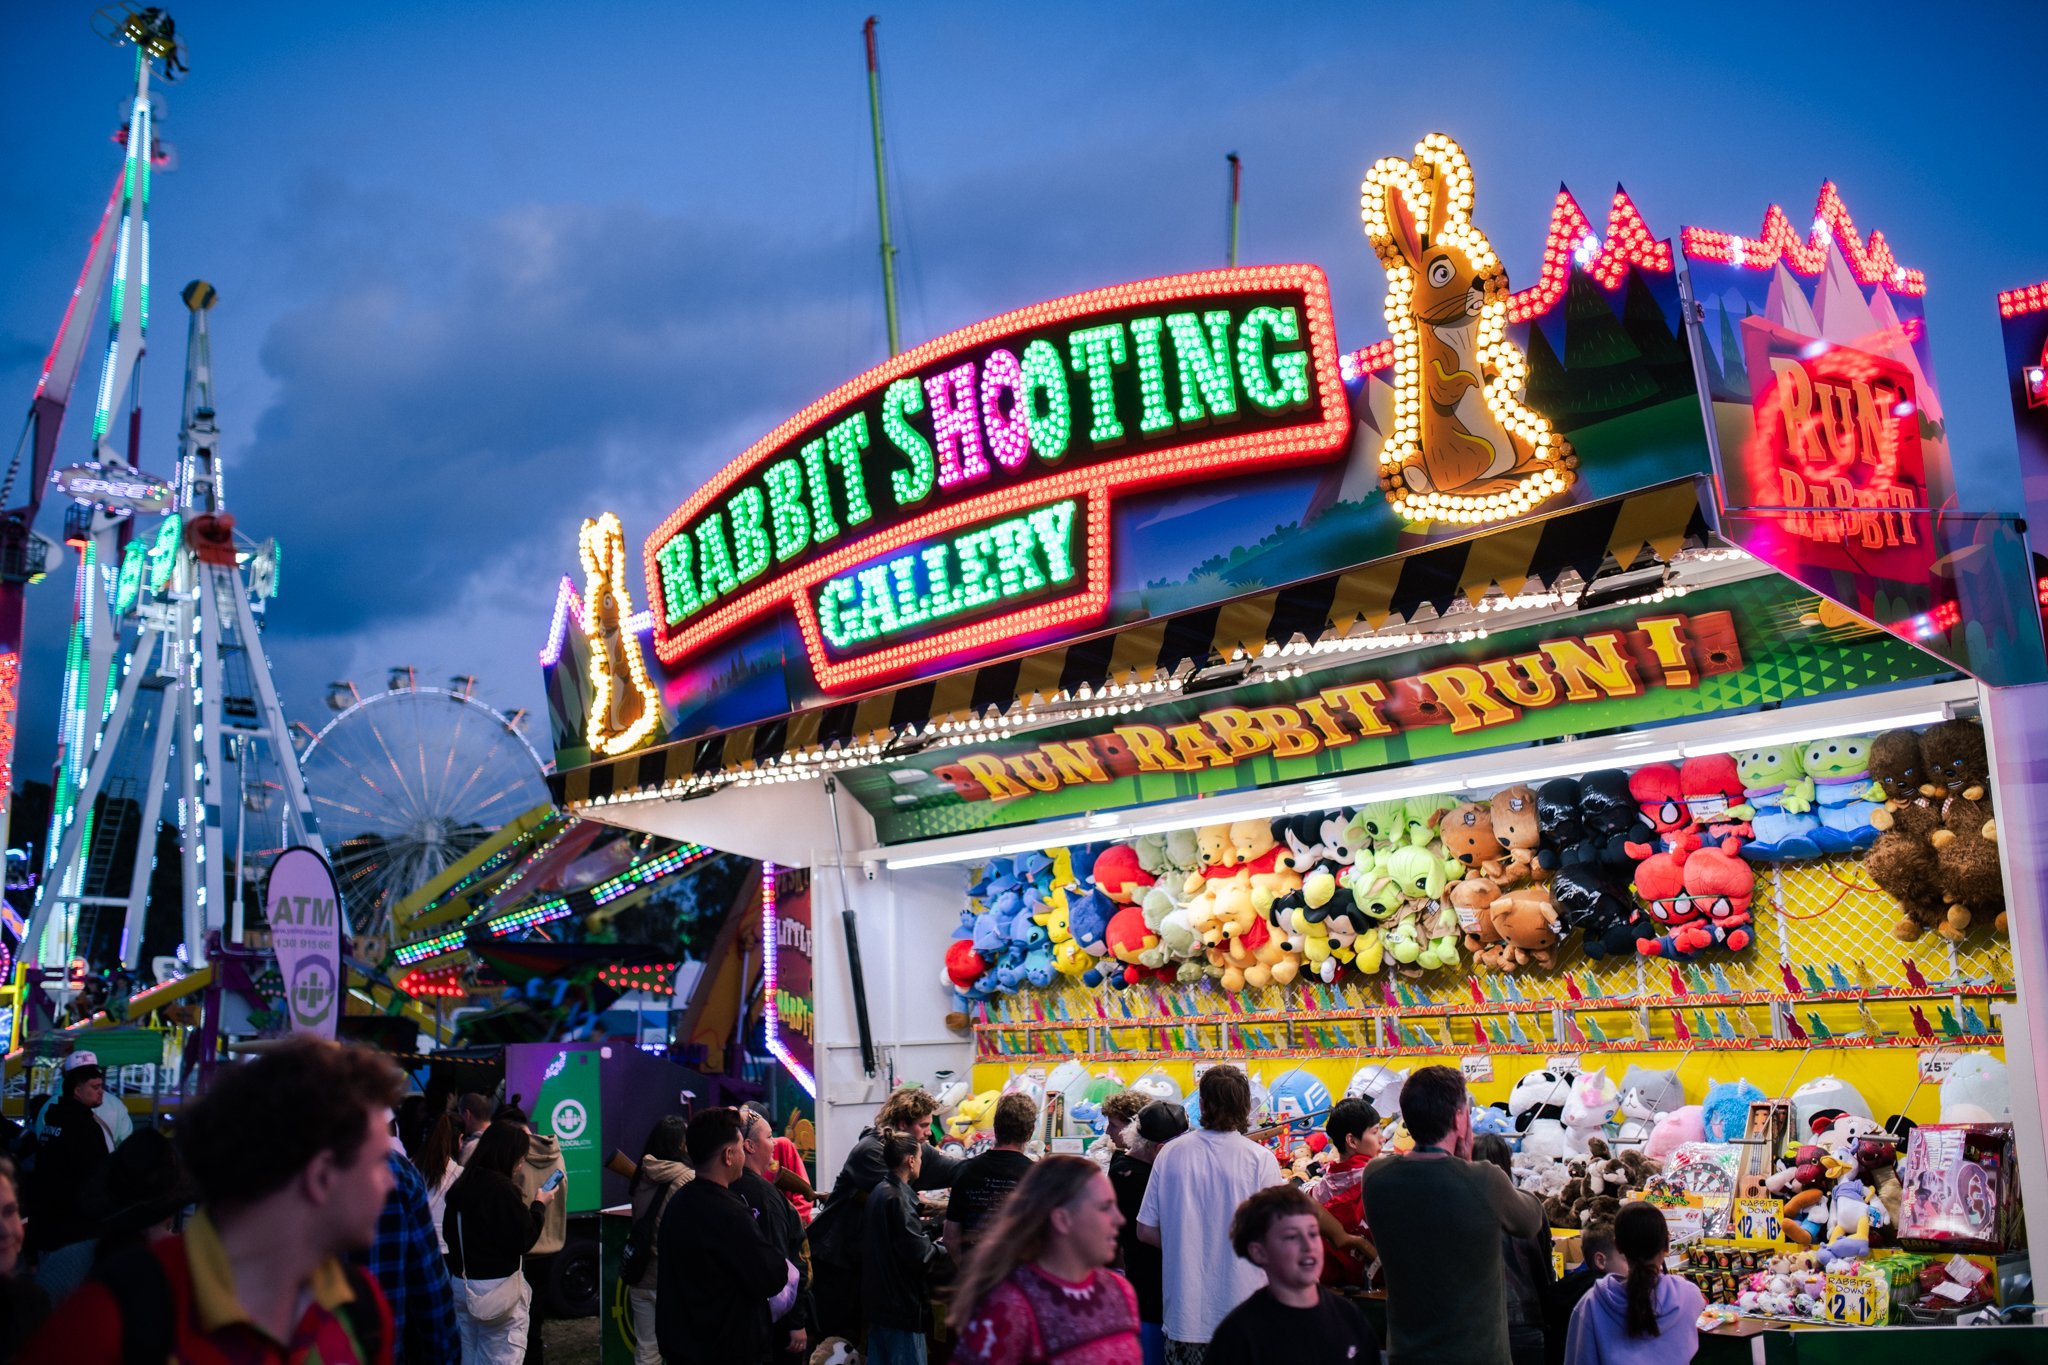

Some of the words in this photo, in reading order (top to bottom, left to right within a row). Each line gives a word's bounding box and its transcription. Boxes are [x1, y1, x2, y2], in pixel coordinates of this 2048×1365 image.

[1769, 357, 1895, 468] RUN
[655, 410, 873, 626] RABBIT
[882, 306, 1310, 506] SHOOTING
[1779, 467, 1916, 549] RABBIT
[817, 499, 1079, 649] GALLERY
[957, 740, 1110, 802] RUN
[1113, 682, 1393, 772] RABBIT
[272, 896, 334, 928] ATM
[1924, 1062, 1942, 1072] 25
[1742, 1215, 1753, 1239] 12
[1766, 1217, 1777, 1240] 16
[1828, 1277, 1872, 1288] RABBITS
[1835, 1286, 1865, 1295] DOWN
[1834, 1294, 1846, 1320] 2
[1859, 1297, 1865, 1322] 1
